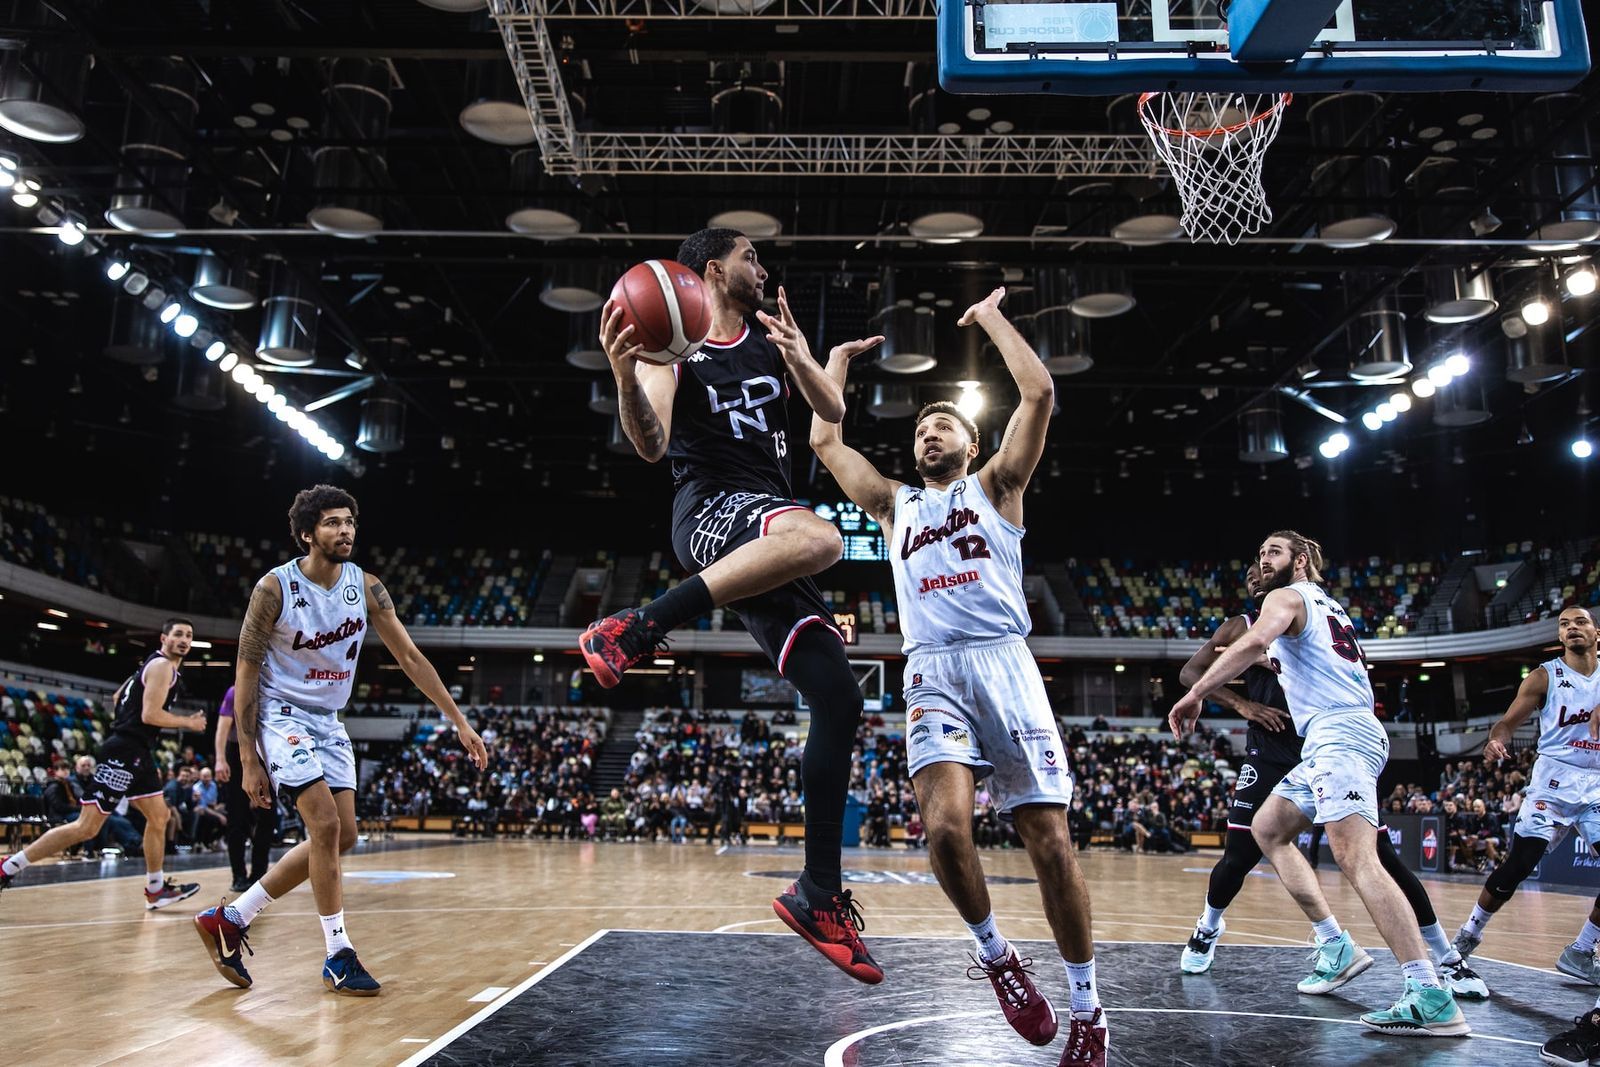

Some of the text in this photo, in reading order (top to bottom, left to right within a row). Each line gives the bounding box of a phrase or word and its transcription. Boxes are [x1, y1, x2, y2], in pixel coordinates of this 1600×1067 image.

[771, 430, 787, 459] 13
[901, 507, 979, 560] Leicester
[951, 534, 991, 561] 12
[918, 569, 980, 593] Jelson
[919, 582, 985, 601] HOMES
[292, 617, 364, 650] Leicester
[346, 640, 358, 661] 4
[305, 667, 351, 680] Jelson
